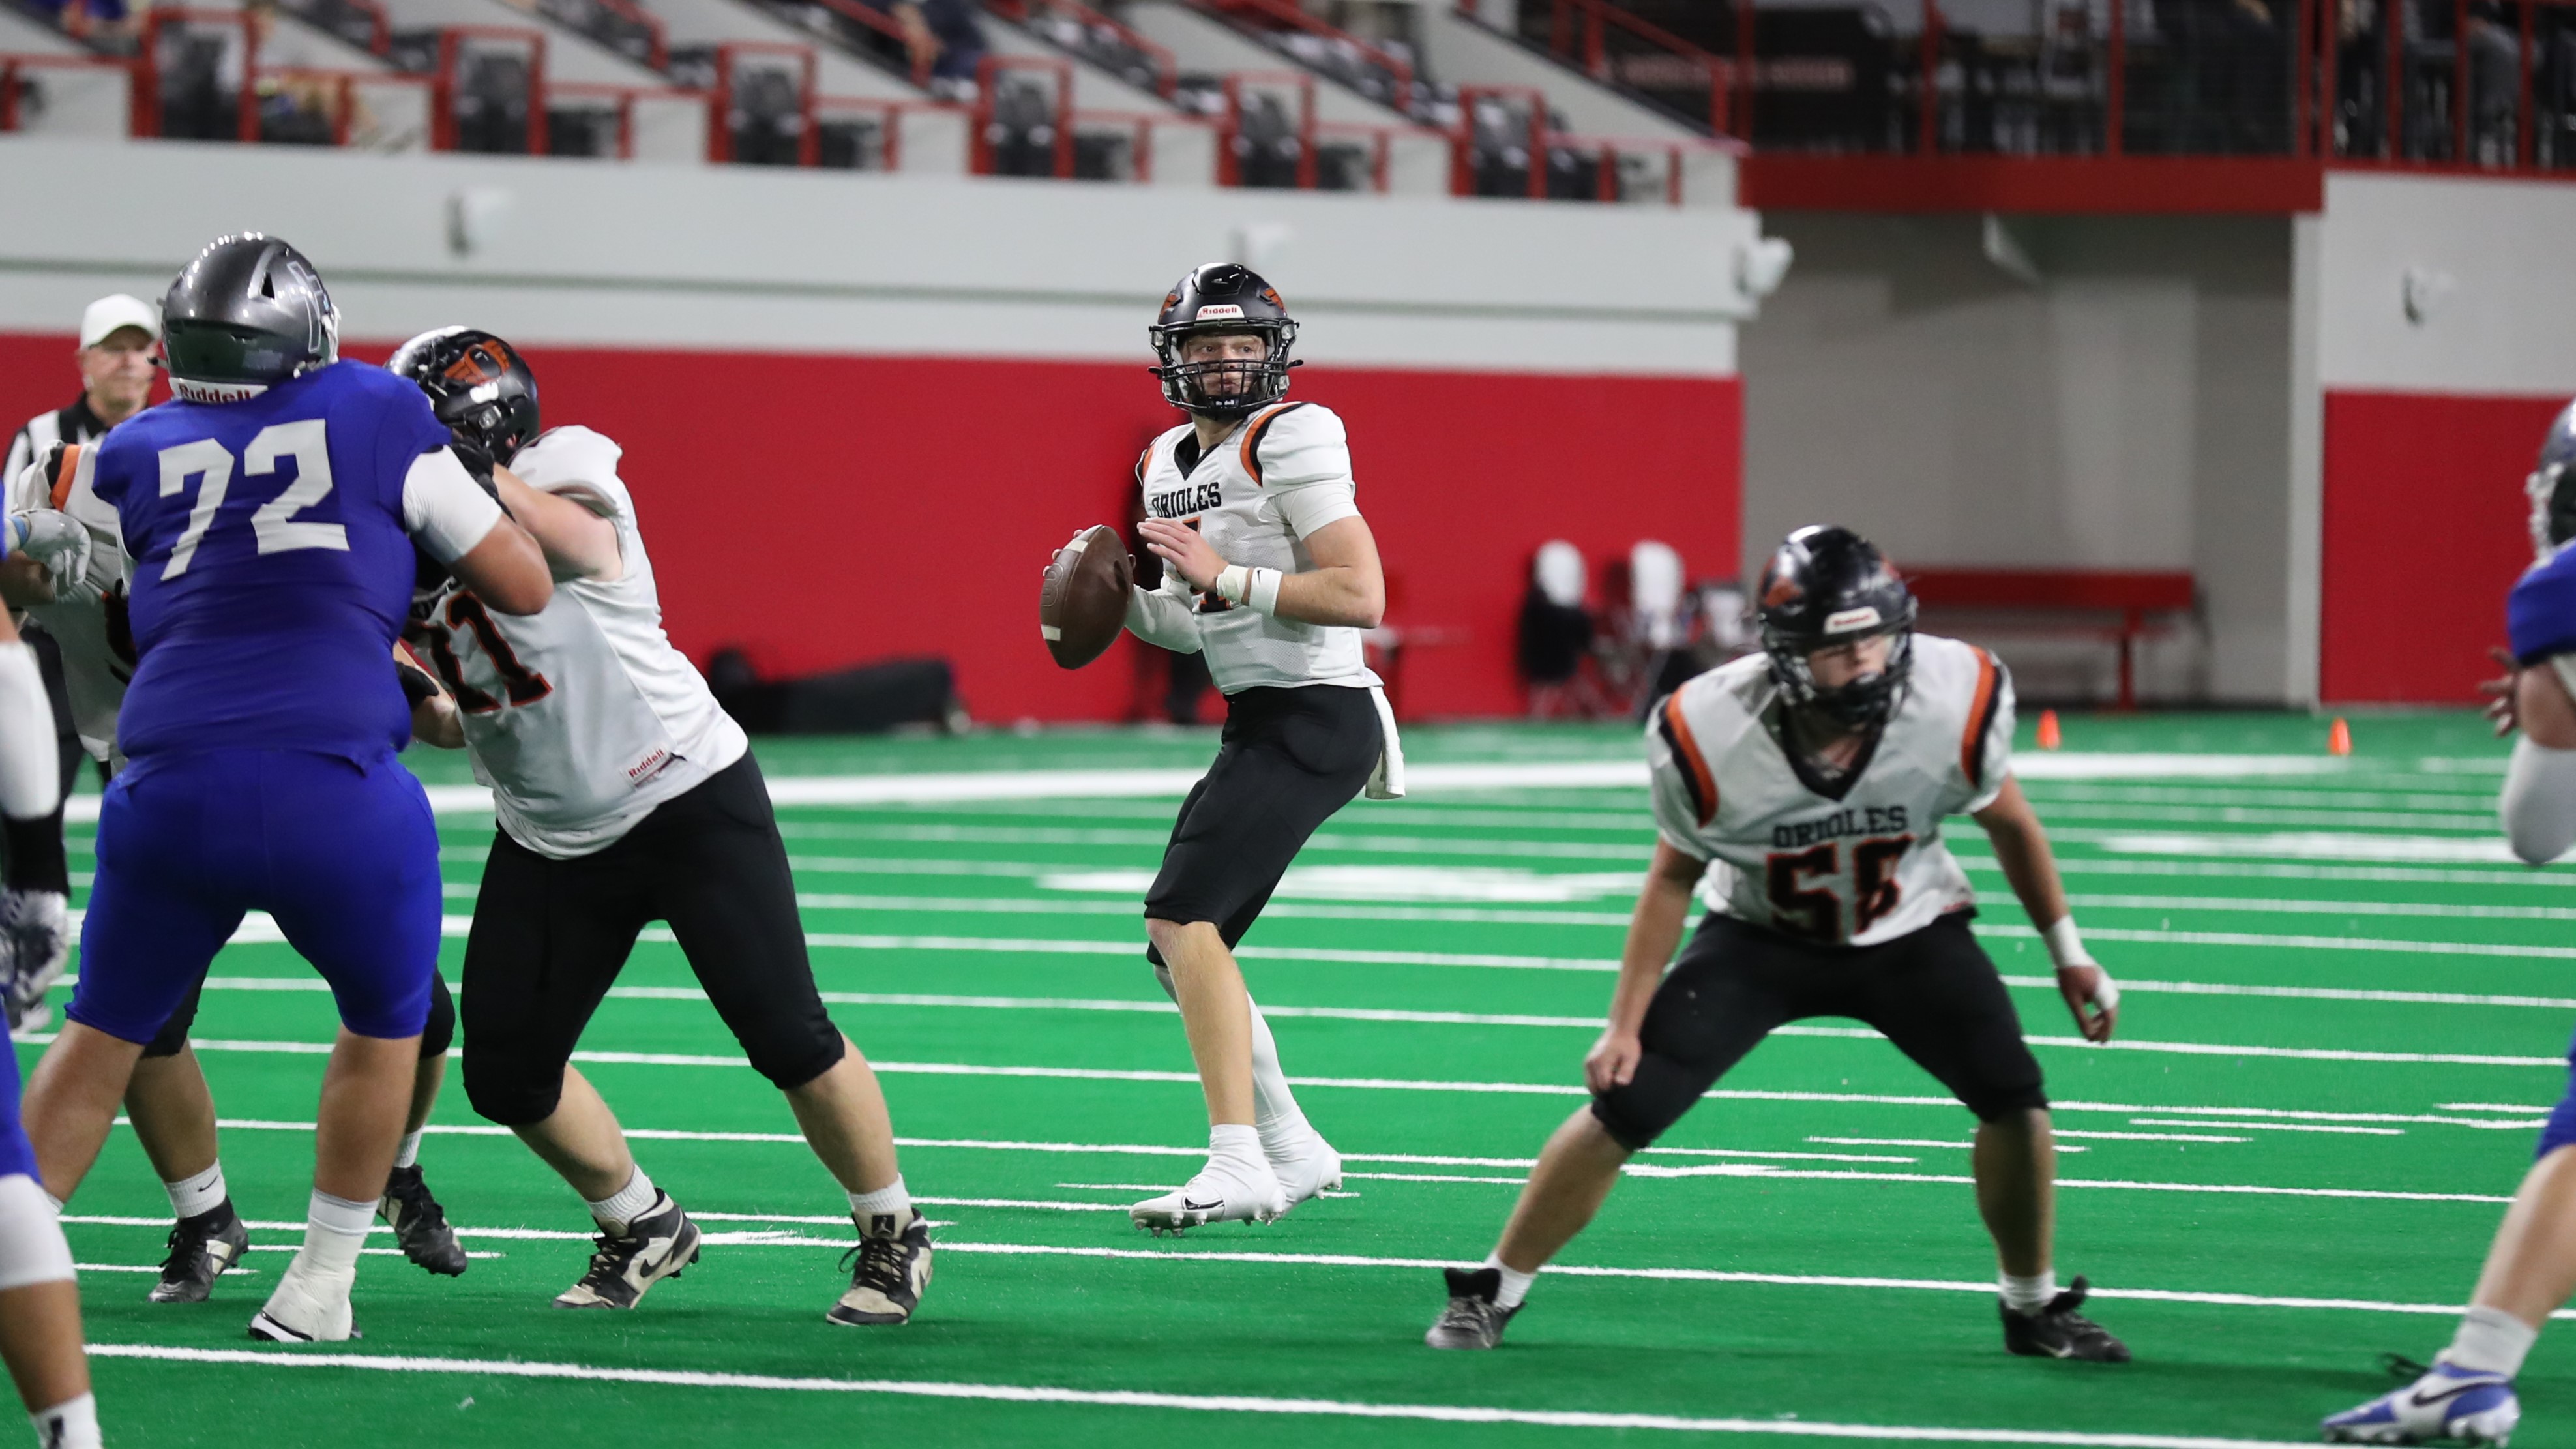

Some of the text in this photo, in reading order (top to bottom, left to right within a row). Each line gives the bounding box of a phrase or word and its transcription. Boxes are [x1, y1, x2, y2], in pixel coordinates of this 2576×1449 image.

[179, 383, 250, 403] Riddell
[158, 419, 351, 581] 72
[1151, 481, 1222, 519] ORIOLES
[628, 749, 664, 778] Riddell
[1773, 806, 1908, 848] ORIOLES
